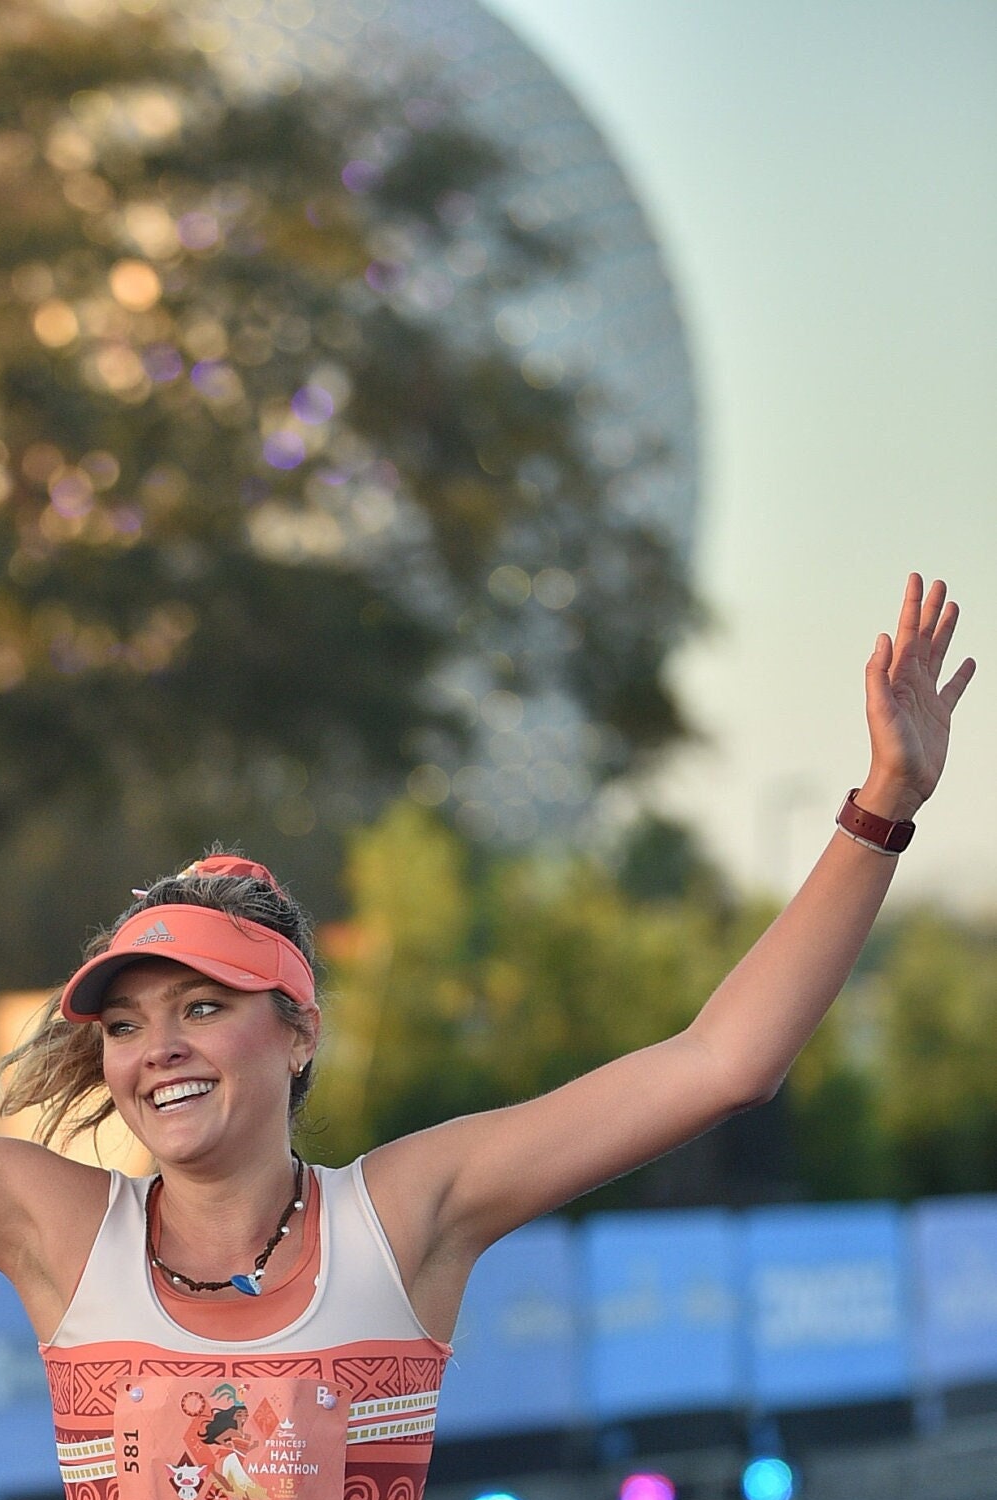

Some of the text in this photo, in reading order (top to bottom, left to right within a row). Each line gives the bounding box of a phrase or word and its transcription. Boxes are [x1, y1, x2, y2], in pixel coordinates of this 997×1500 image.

[132, 934, 176, 947] adidas
[316, 1386, 329, 1405] B
[265, 1440, 306, 1448] PRINCESS
[123, 1429, 139, 1474] 581
[270, 1450, 302, 1461] HALF
[248, 1463, 319, 1475] MARATHON
[279, 1478, 294, 1489] 15
